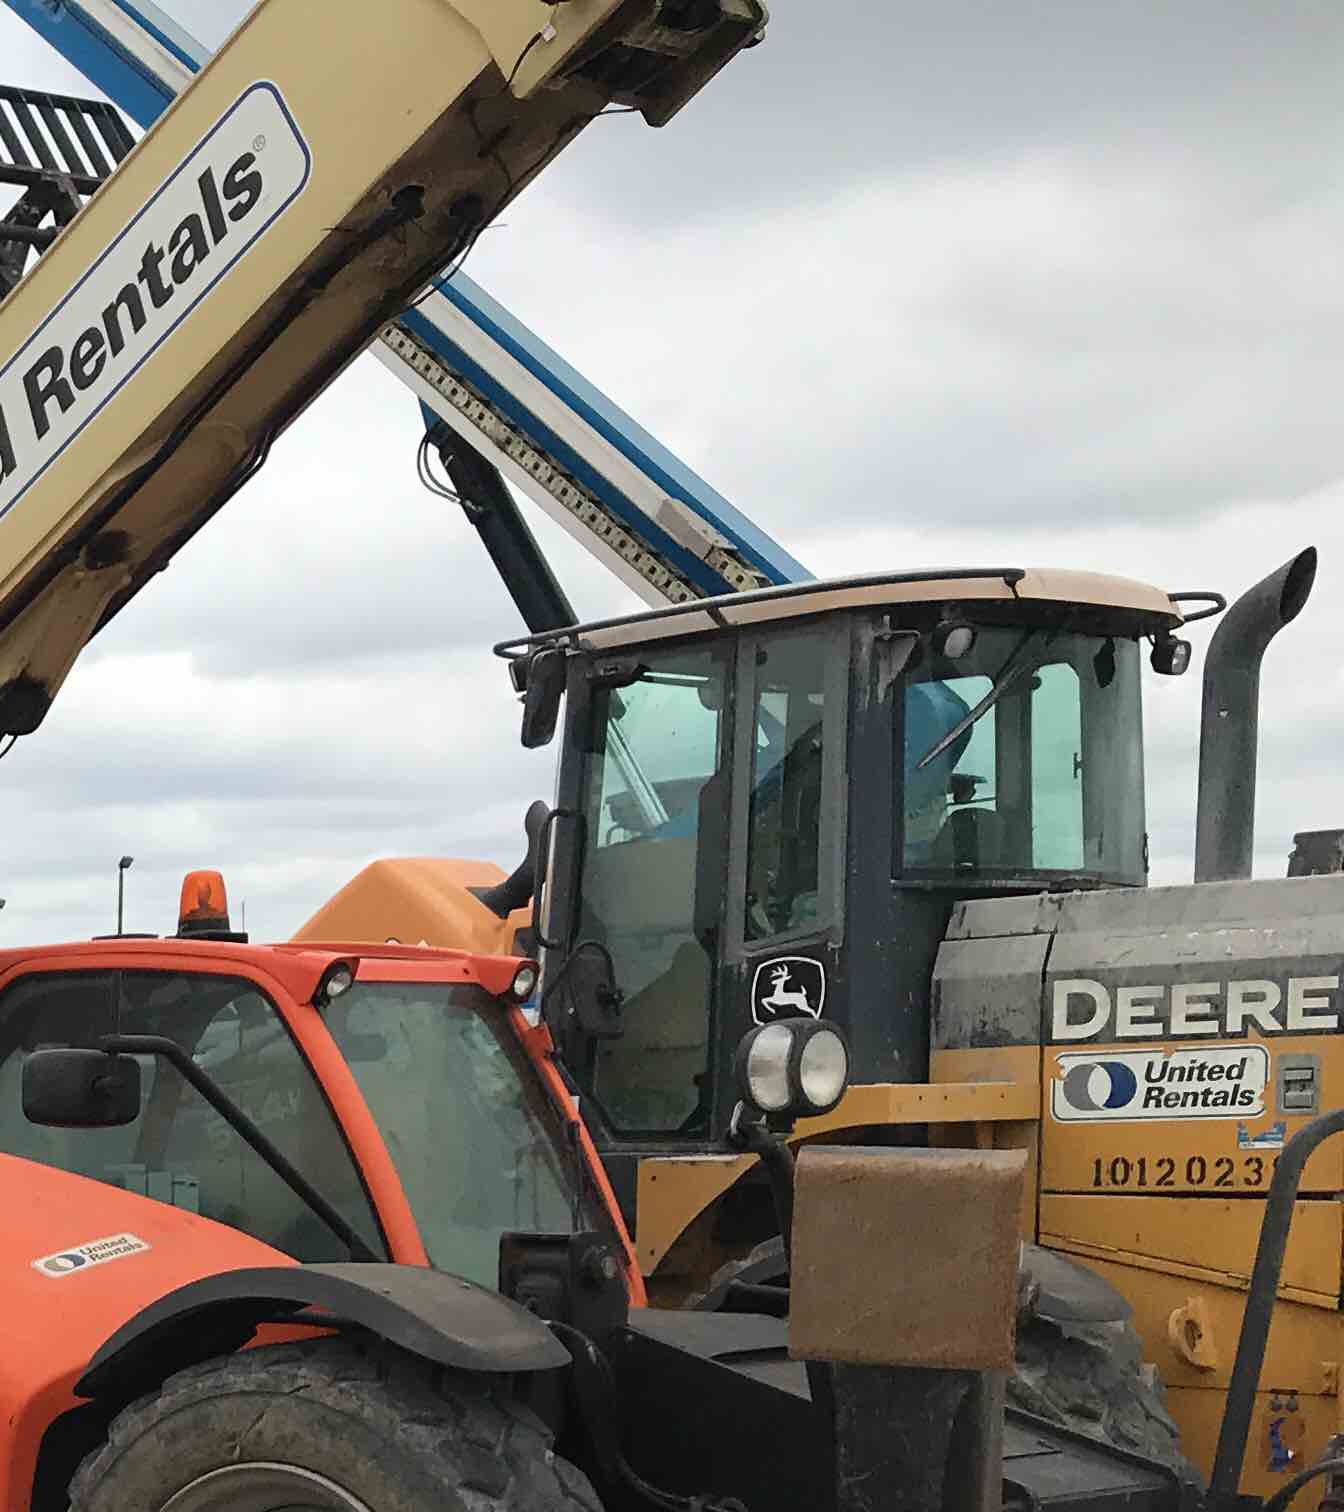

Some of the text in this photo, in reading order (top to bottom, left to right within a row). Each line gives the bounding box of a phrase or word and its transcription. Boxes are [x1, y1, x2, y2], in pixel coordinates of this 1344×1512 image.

[22, 150, 264, 441] Rentals
[1052, 975, 1339, 1040] DEERE
[1144, 1056, 1247, 1083] United
[1142, 1084, 1255, 1109] Rentals
[1093, 1155, 1280, 1187] 1012023
[80, 1237, 128, 1255] United
[89, 1242, 142, 1262] Rentals
